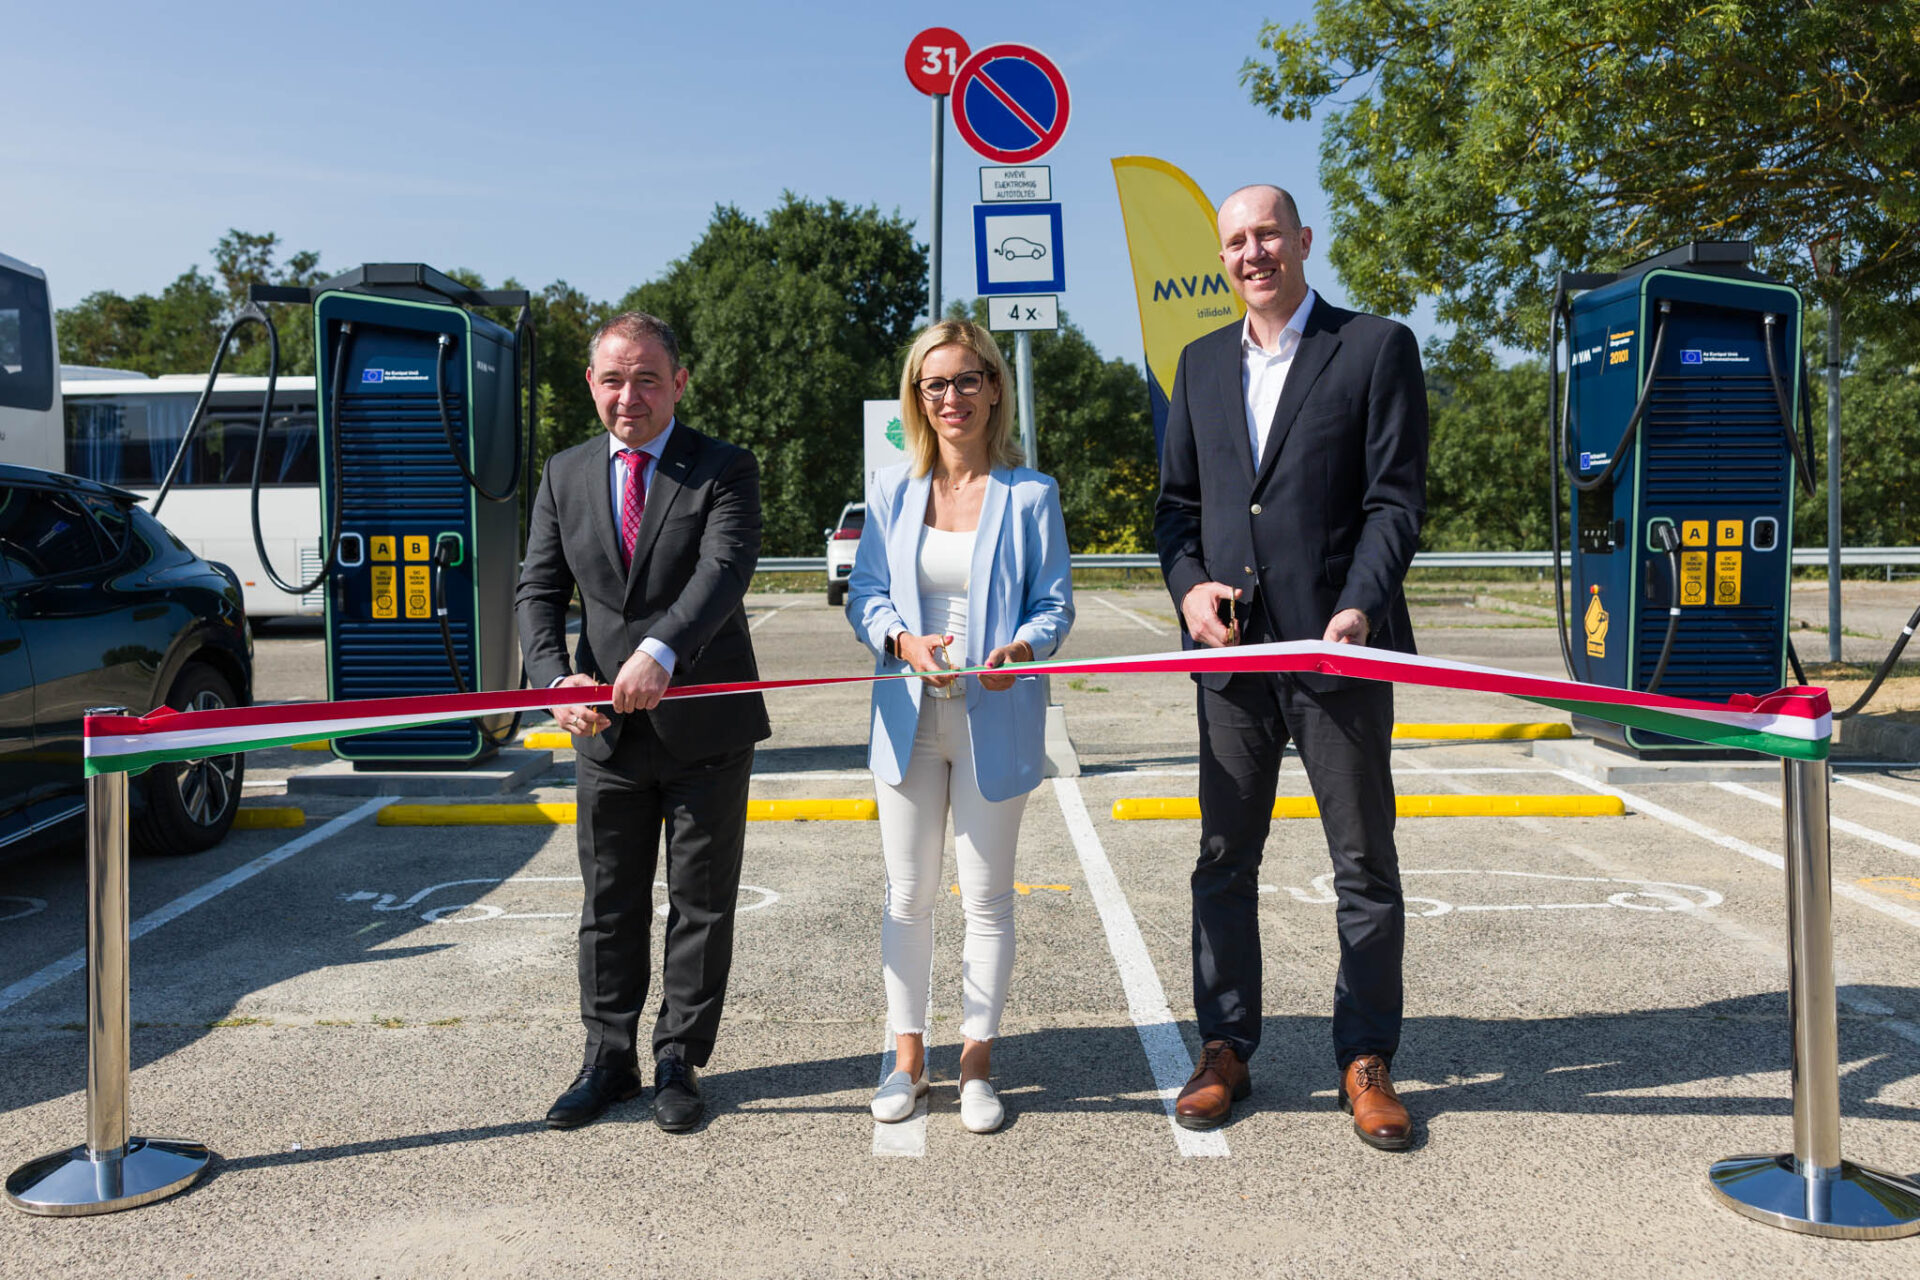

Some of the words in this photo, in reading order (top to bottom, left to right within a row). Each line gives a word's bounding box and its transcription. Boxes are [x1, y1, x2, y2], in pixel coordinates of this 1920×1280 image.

[921, 46, 957, 75] 31
[1010, 304, 1020, 321] 4
[1025, 308, 1038, 321] x
[1689, 528, 1700, 539] A
[1725, 527, 1735, 539] B
[377, 543, 389, 554] A
[411, 543, 421, 553] B
